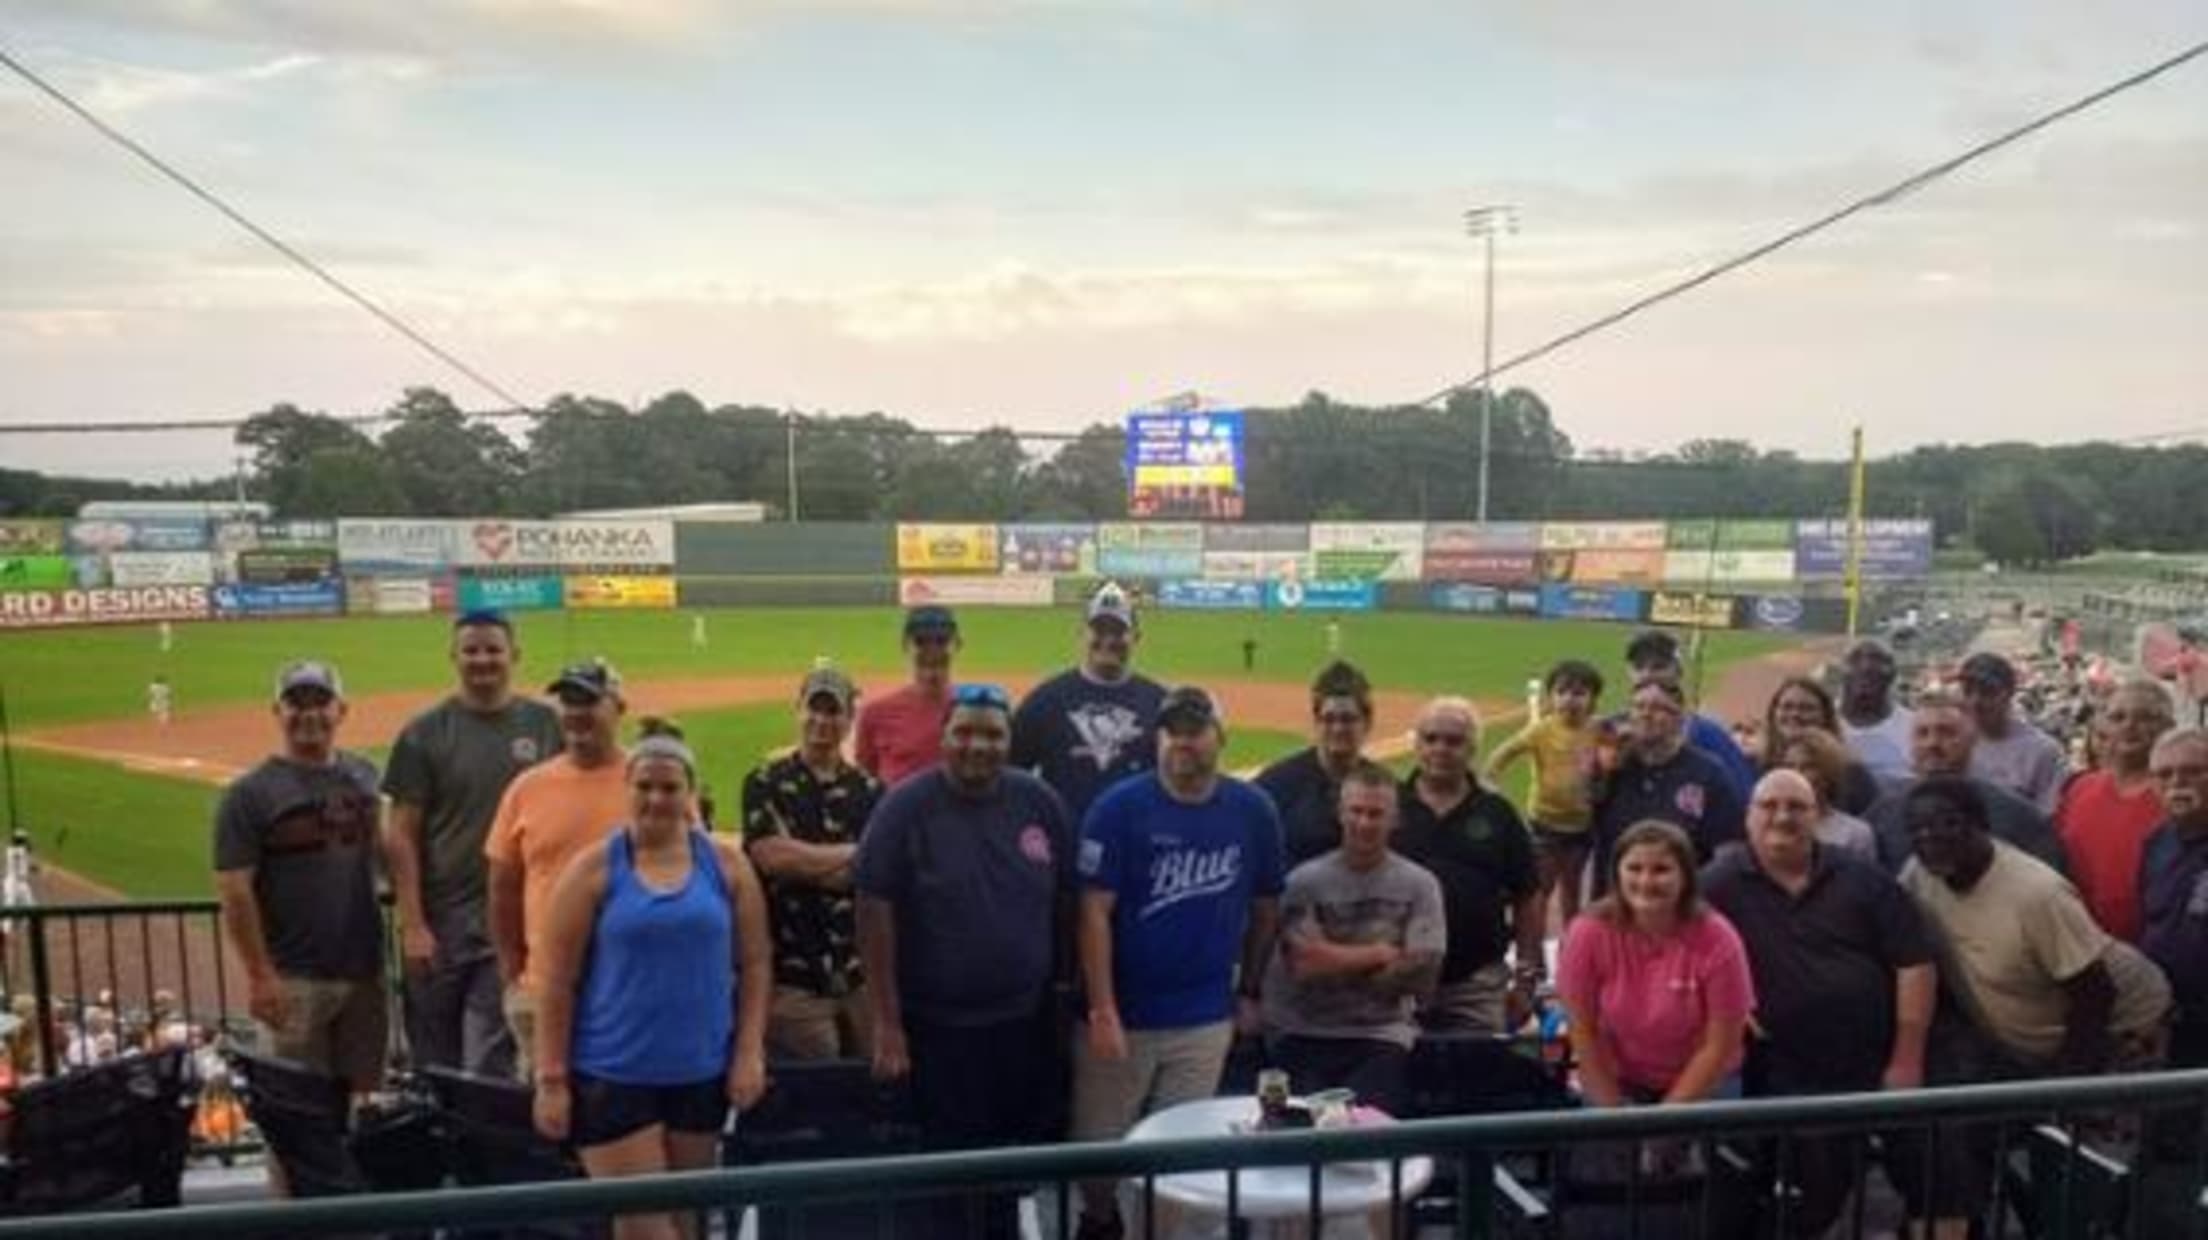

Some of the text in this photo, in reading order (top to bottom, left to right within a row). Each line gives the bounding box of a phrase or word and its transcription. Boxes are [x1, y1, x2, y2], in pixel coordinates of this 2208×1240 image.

[516, 526, 654, 547] POHANKA
[63, 585, 208, 614] DESIGNS
[1150, 845, 1241, 896] Blue
